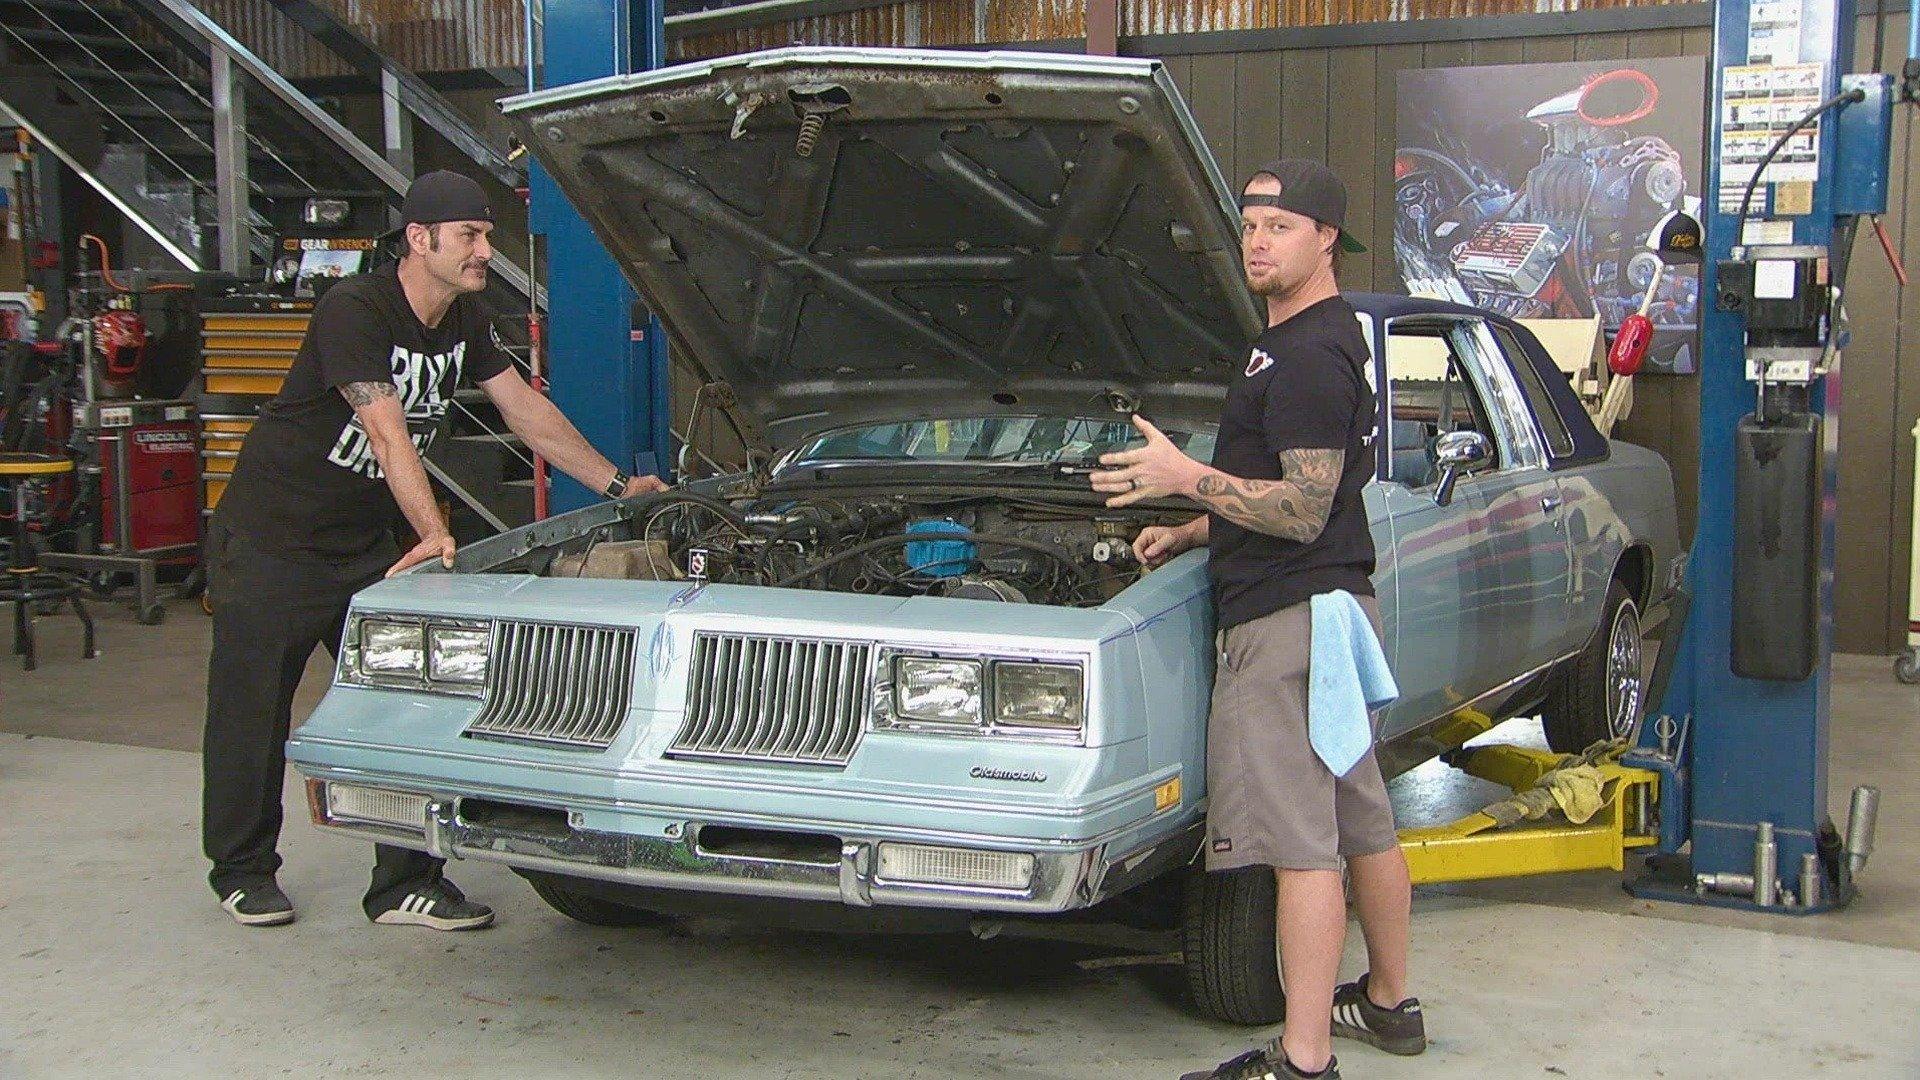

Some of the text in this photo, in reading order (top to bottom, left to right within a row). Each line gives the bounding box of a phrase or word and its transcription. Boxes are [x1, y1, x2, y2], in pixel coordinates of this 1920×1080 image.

[136, 431, 190, 442] LINCOLN
[148, 442, 196, 452] ELECTRIC
[969, 765, 1047, 782] Oldsmobile
